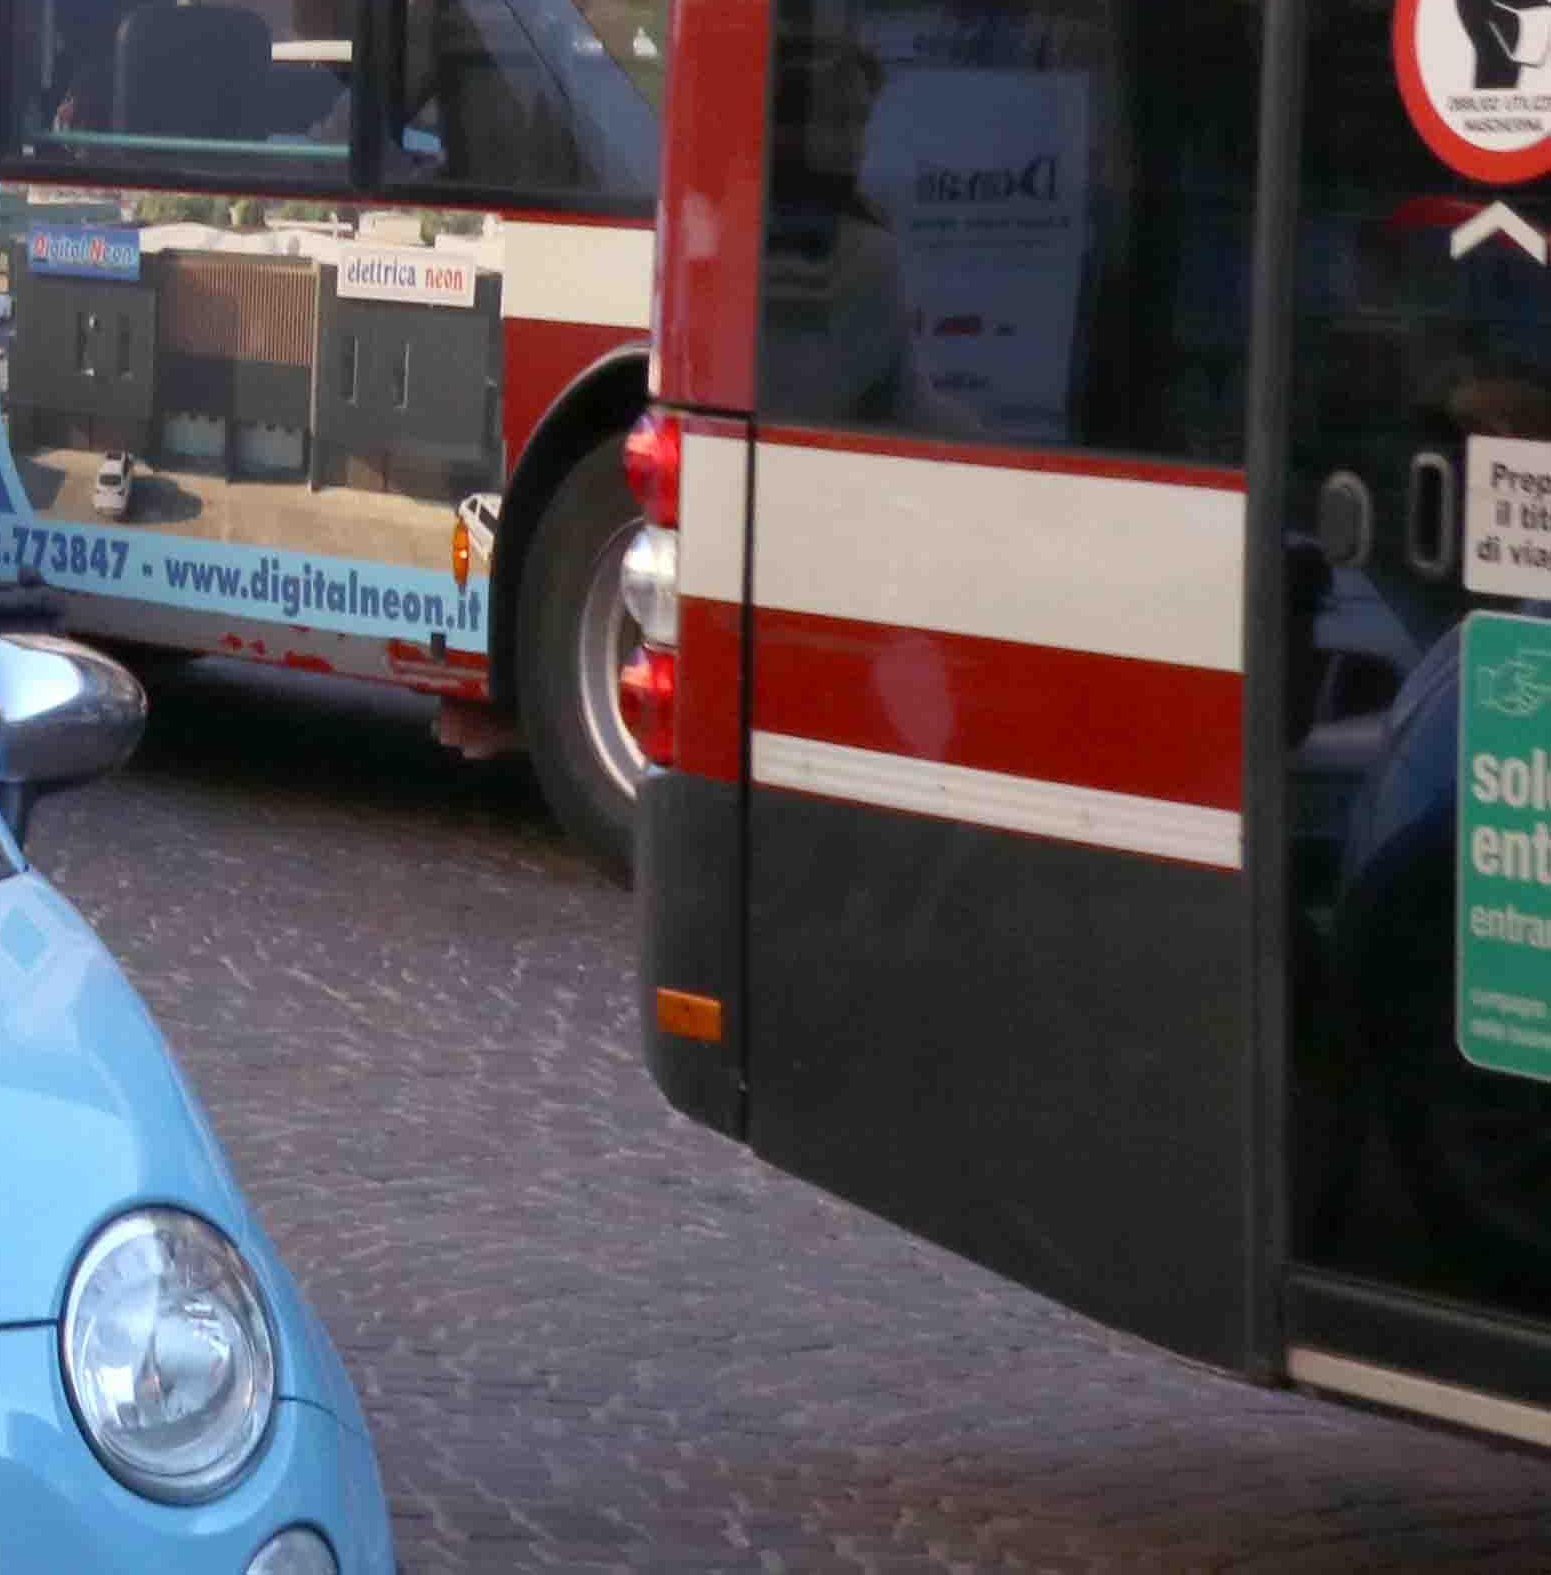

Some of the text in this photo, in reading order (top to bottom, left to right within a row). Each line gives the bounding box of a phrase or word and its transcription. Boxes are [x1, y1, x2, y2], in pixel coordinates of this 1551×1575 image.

[347, 255, 464, 292] elettrica neon
[165, 554, 481, 630] www.digitalneon.it
